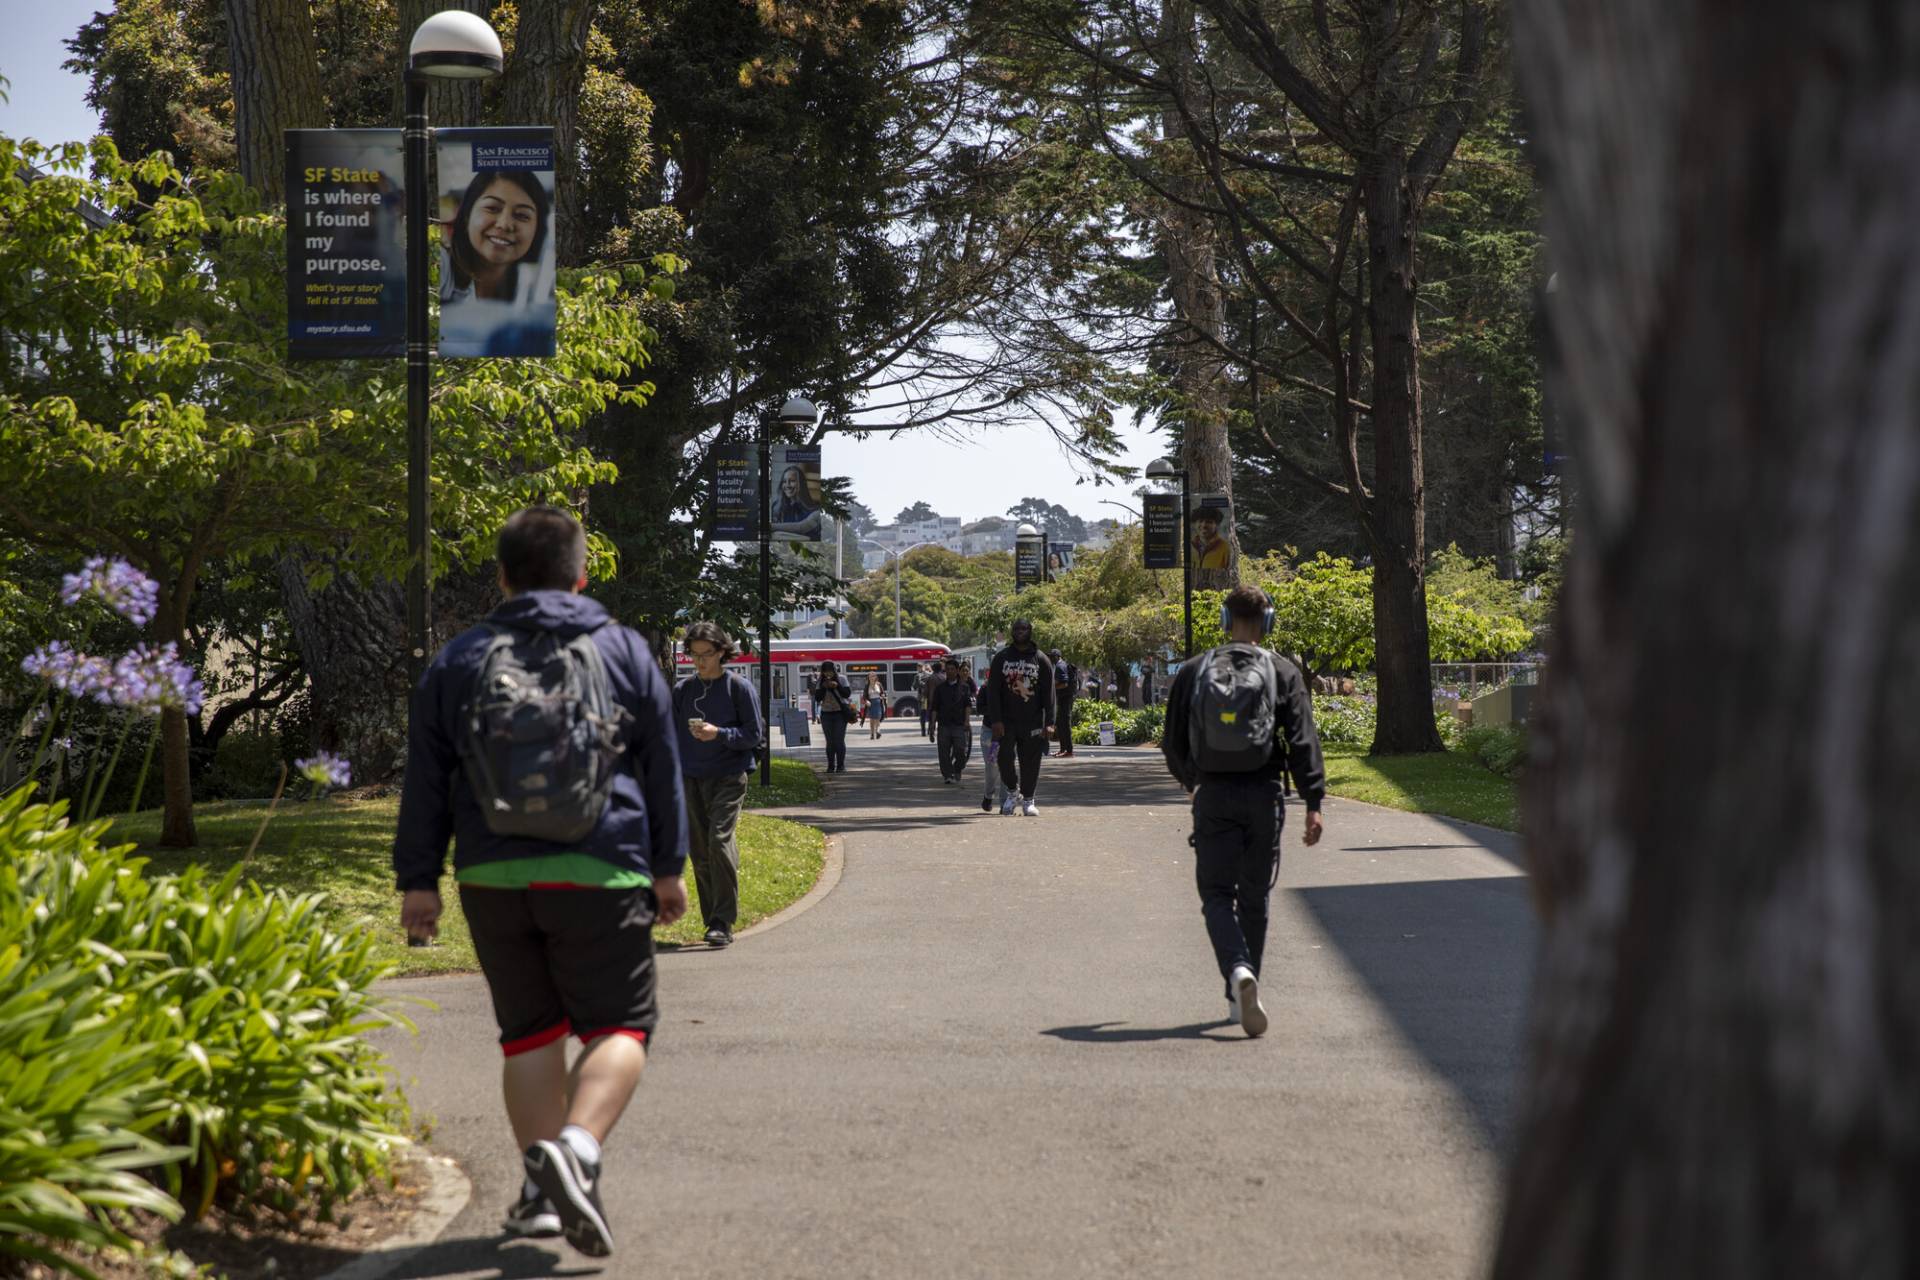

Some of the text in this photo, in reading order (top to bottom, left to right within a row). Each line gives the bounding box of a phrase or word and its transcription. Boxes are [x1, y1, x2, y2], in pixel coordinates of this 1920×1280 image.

[498, 146, 549, 156] FRANCISCO
[502, 159, 549, 167] UNIVERSITY
[304, 168, 380, 183] SF State
[304, 189, 382, 206] is where
[306, 211, 370, 228] I found
[306, 235, 334, 252] my
[306, 257, 386, 274] purpose.
[306, 283, 384, 294] What's your story?
[306, 296, 321, 305] Tell
[322, 296, 329, 305] it
[330, 296, 340, 305] at
[342, 296, 352, 305] SF
[717, 478, 744, 486] faculty
